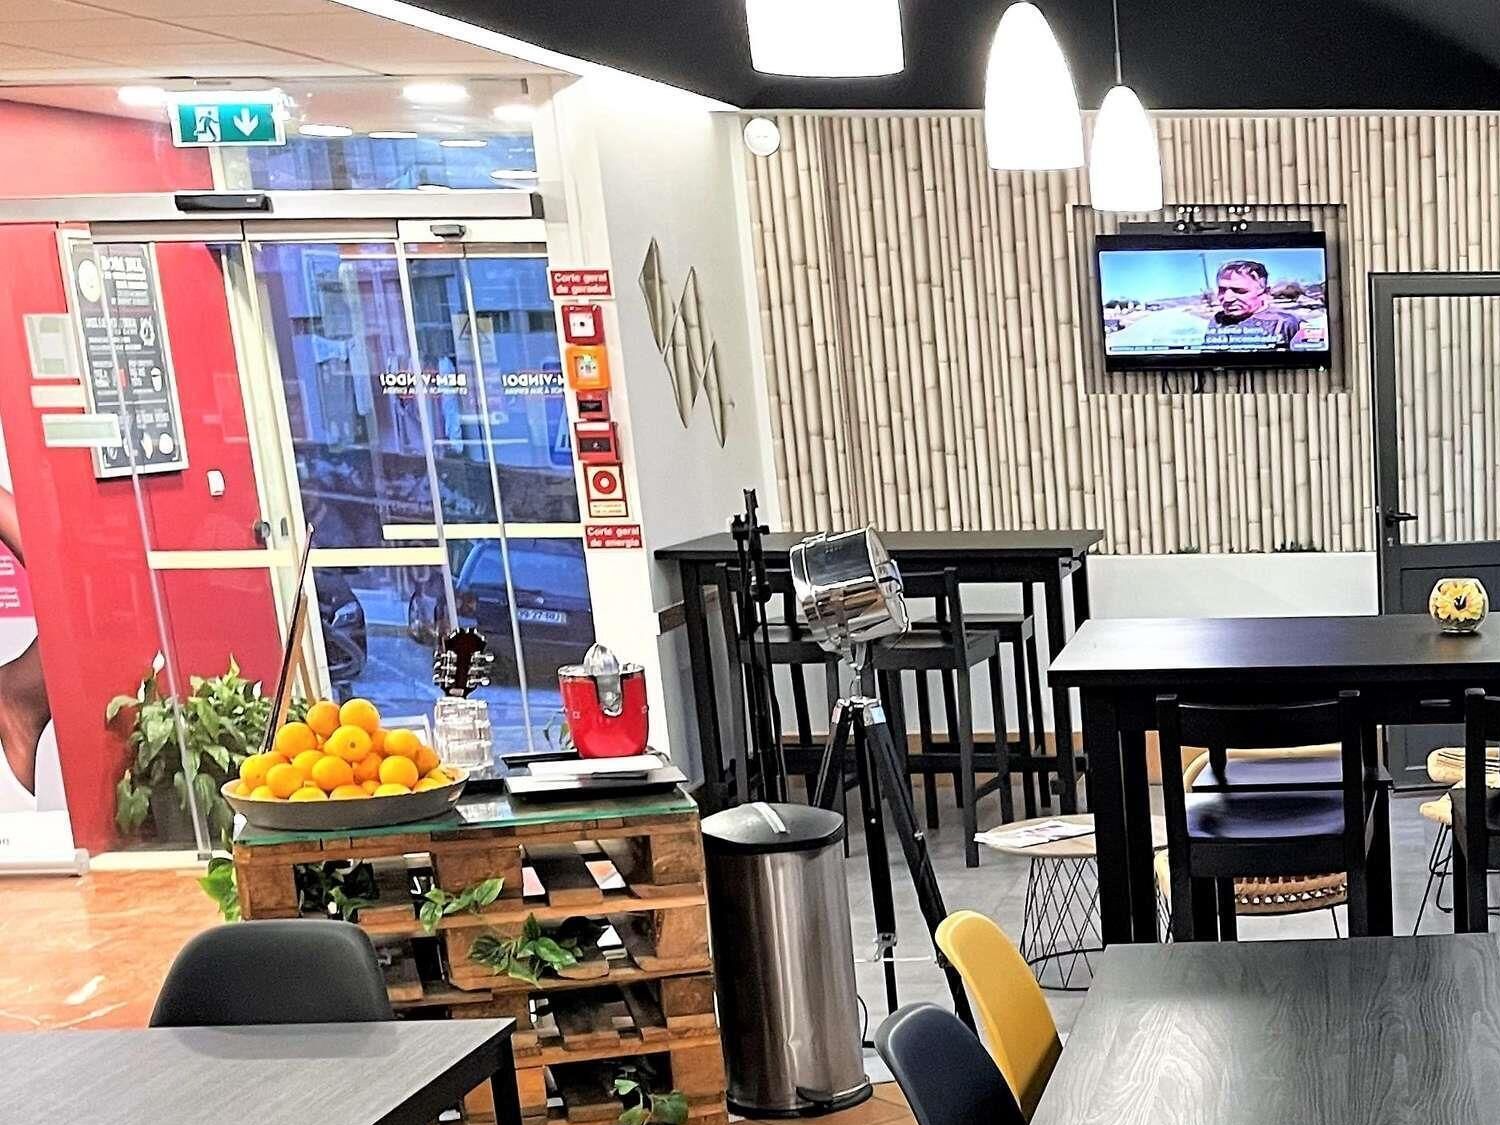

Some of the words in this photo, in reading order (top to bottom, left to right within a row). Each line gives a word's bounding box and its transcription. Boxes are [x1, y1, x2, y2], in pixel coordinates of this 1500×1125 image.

[554, 272, 581, 283] Corte
[587, 527, 612, 536] Corte
[616, 526, 639, 537] geral
[590, 538, 602, 547] de
[605, 538, 640, 548] energia
